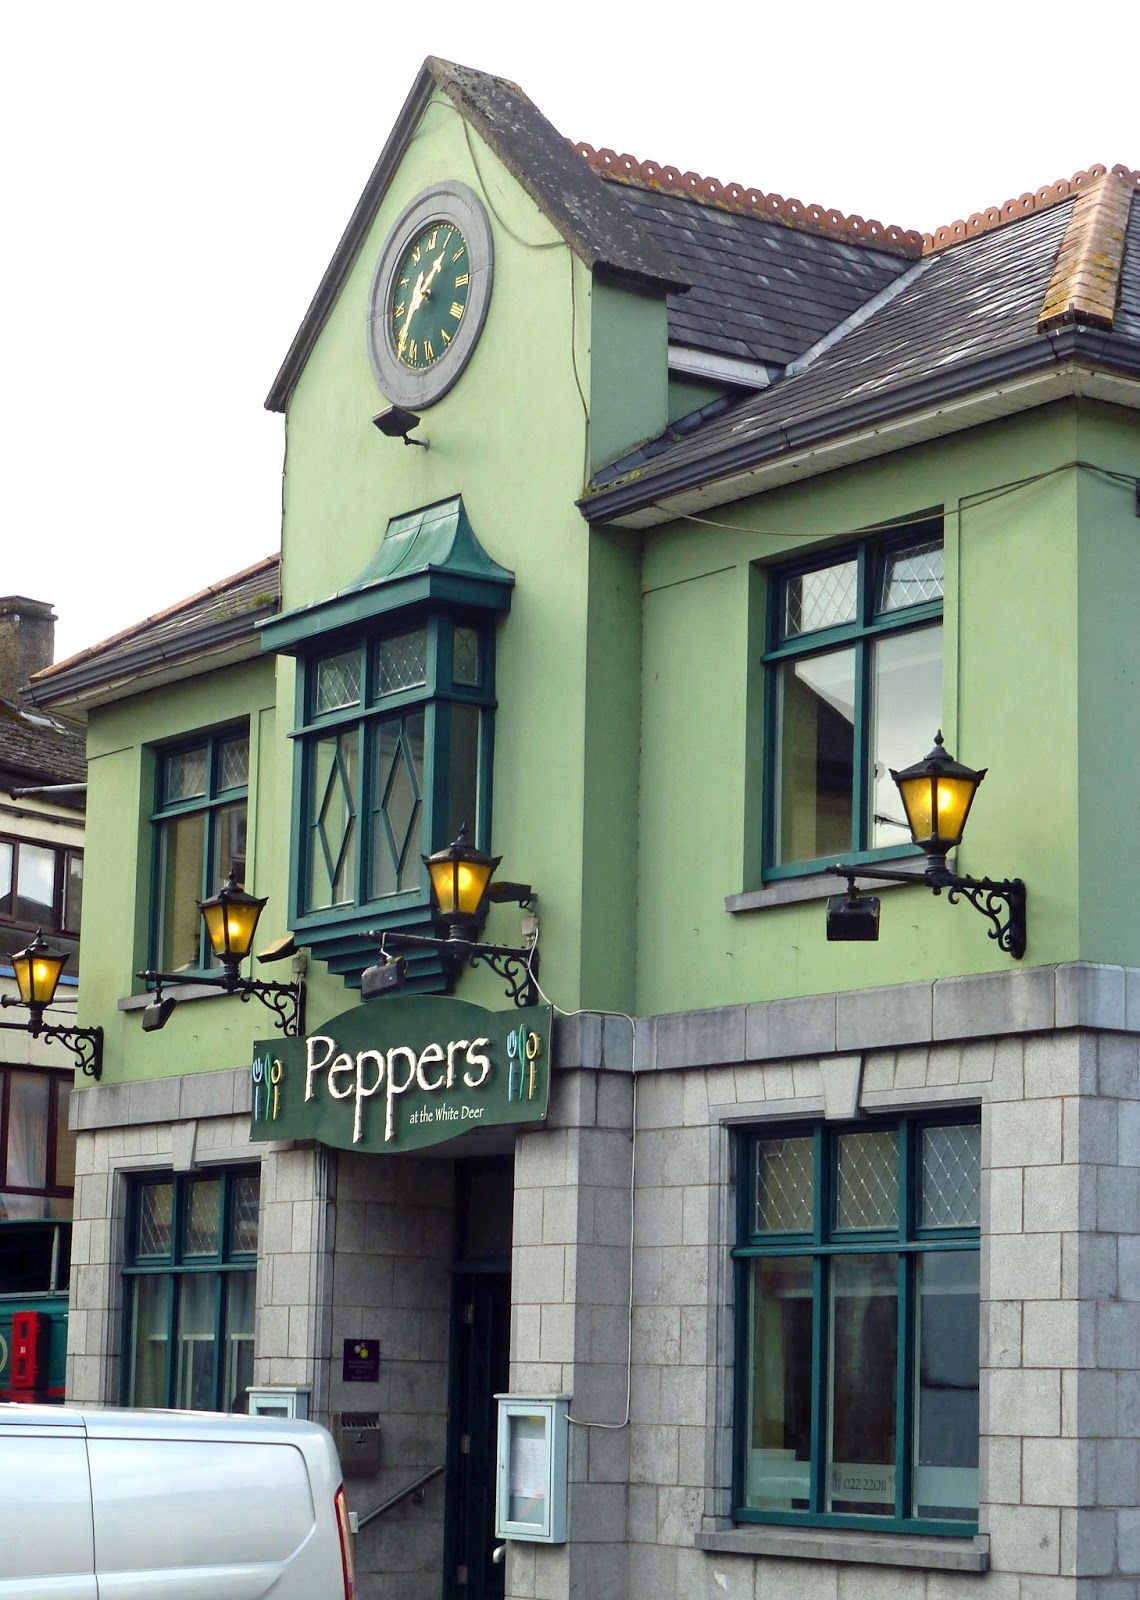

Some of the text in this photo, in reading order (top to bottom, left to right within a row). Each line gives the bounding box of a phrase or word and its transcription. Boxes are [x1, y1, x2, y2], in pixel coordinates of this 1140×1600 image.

[455, 273, 469, 289] III
[304, 1035, 490, 1143] Peppers
[409, 1102, 485, 1124] at the White Deer
[843, 1478, 887, 1491] 022 22011
